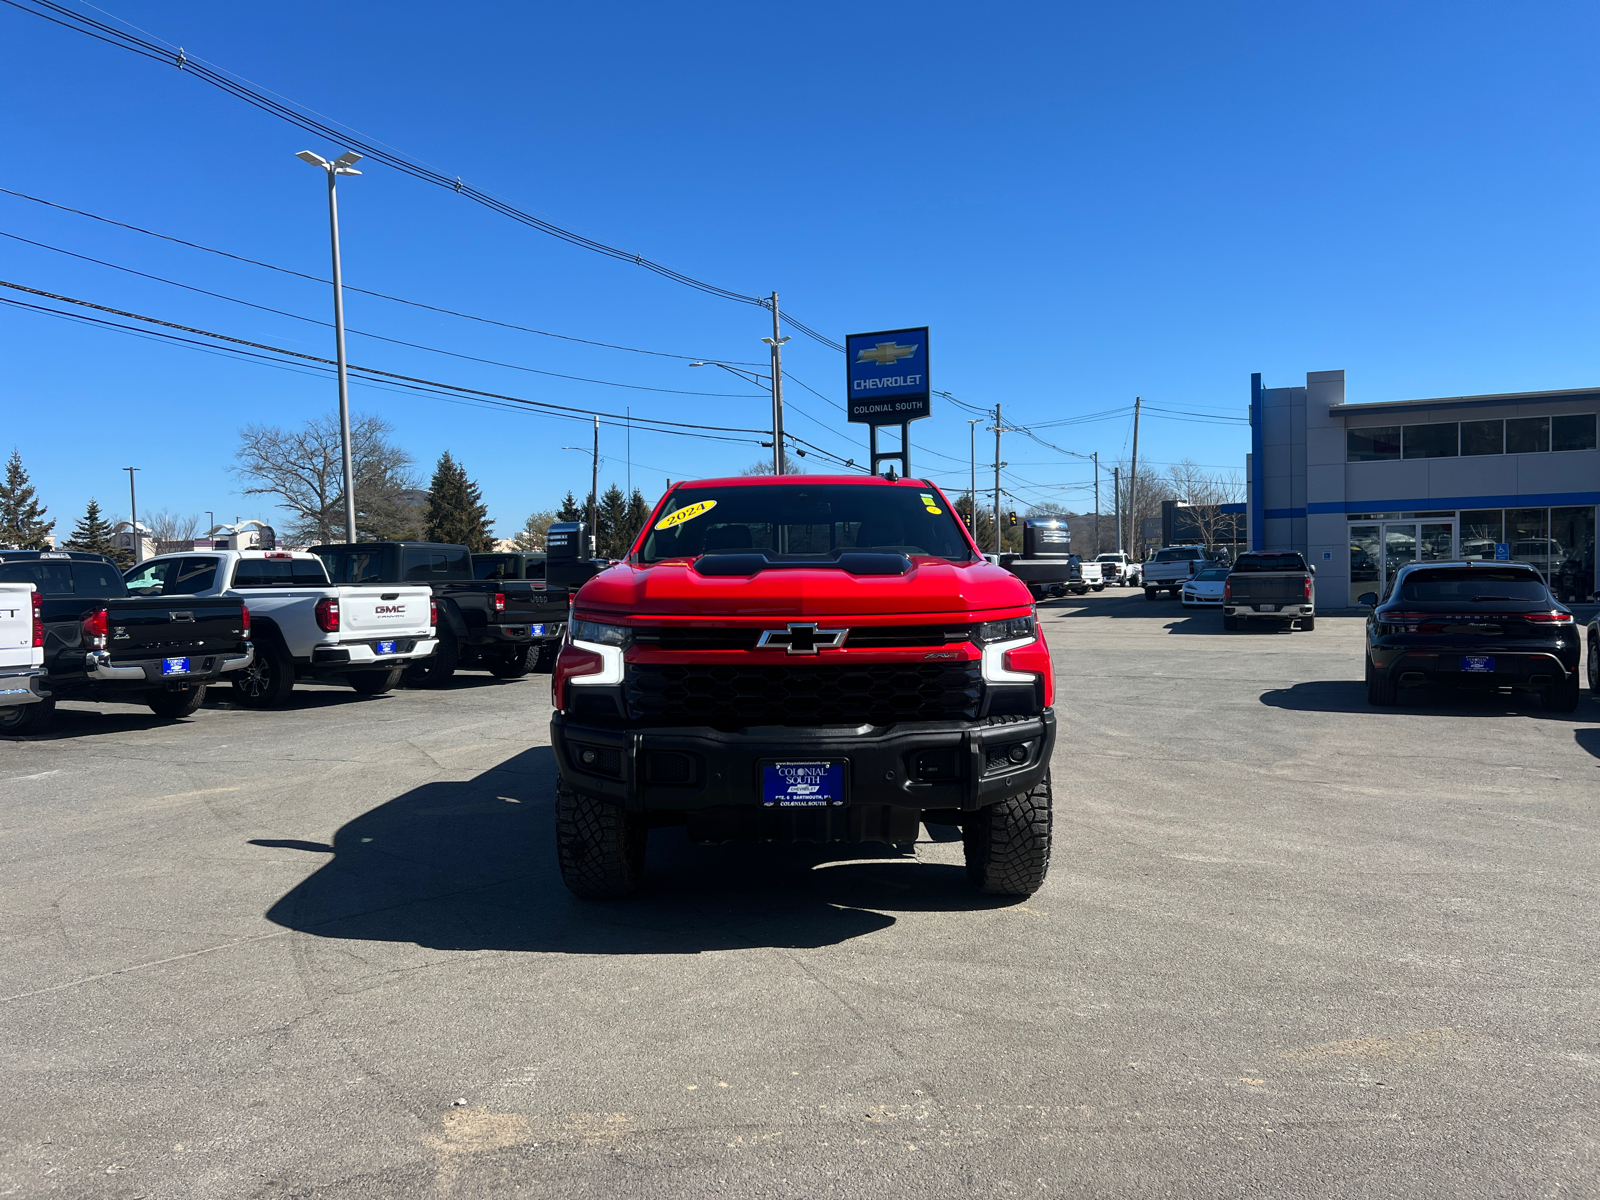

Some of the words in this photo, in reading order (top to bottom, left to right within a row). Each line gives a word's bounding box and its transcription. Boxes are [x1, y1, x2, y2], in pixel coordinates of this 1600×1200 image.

[853, 374, 922, 390] CHEVROLET
[853, 404, 893, 414] COLONIAL
[895, 401, 923, 411] SOUTH
[667, 503, 706, 526] 2024
[530, 593, 548, 605] Jeep
[375, 604, 406, 614] GMC
[778, 768, 828, 776] COLONIAL
[785, 776, 820, 784] SOUTH
